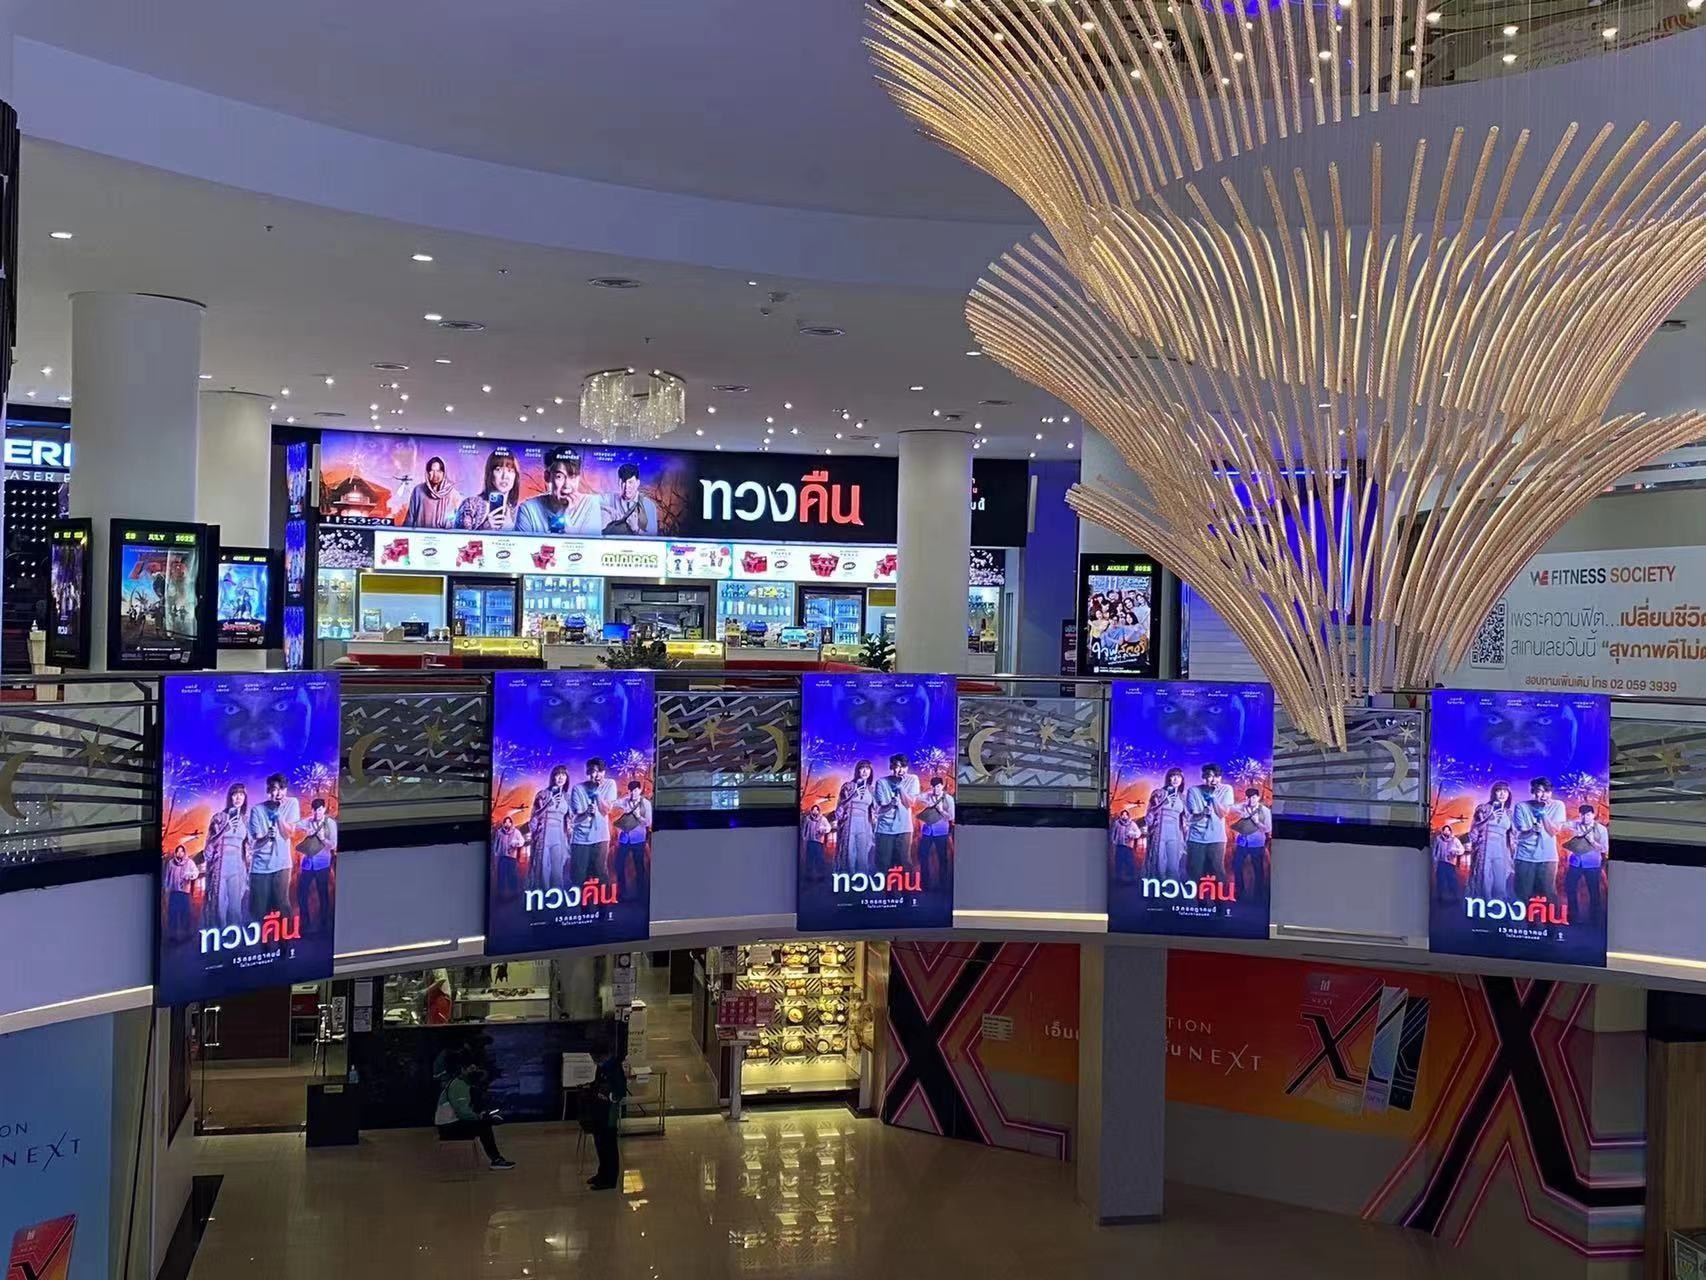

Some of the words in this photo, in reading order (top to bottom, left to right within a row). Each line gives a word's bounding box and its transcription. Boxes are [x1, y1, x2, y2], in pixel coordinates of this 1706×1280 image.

[3, 470, 54, 482] ASER
[699, 469, 865, 526] ทวงคืน
[326, 515, 391, 525] 11:53:20
[1551, 567, 1606, 586] FITNESS
[1610, 565, 1676, 583] SOCIETY
[1610, 679, 1623, 689] 02
[1625, 679, 1647, 690] 059
[1649, 680, 1677, 692] 3939
[832, 865, 922, 893] ทวงคืน
[1142, 874, 1237, 902] ทวงคืน
[525, 876, 619, 912] ทวงคืน
[1465, 895, 1570, 926] ทวงคืน
[199, 910, 301, 954] ทวงคืน
[1189, 1044, 1263, 1076] NEXT
[2, 1127, 81, 1171] NEXT
